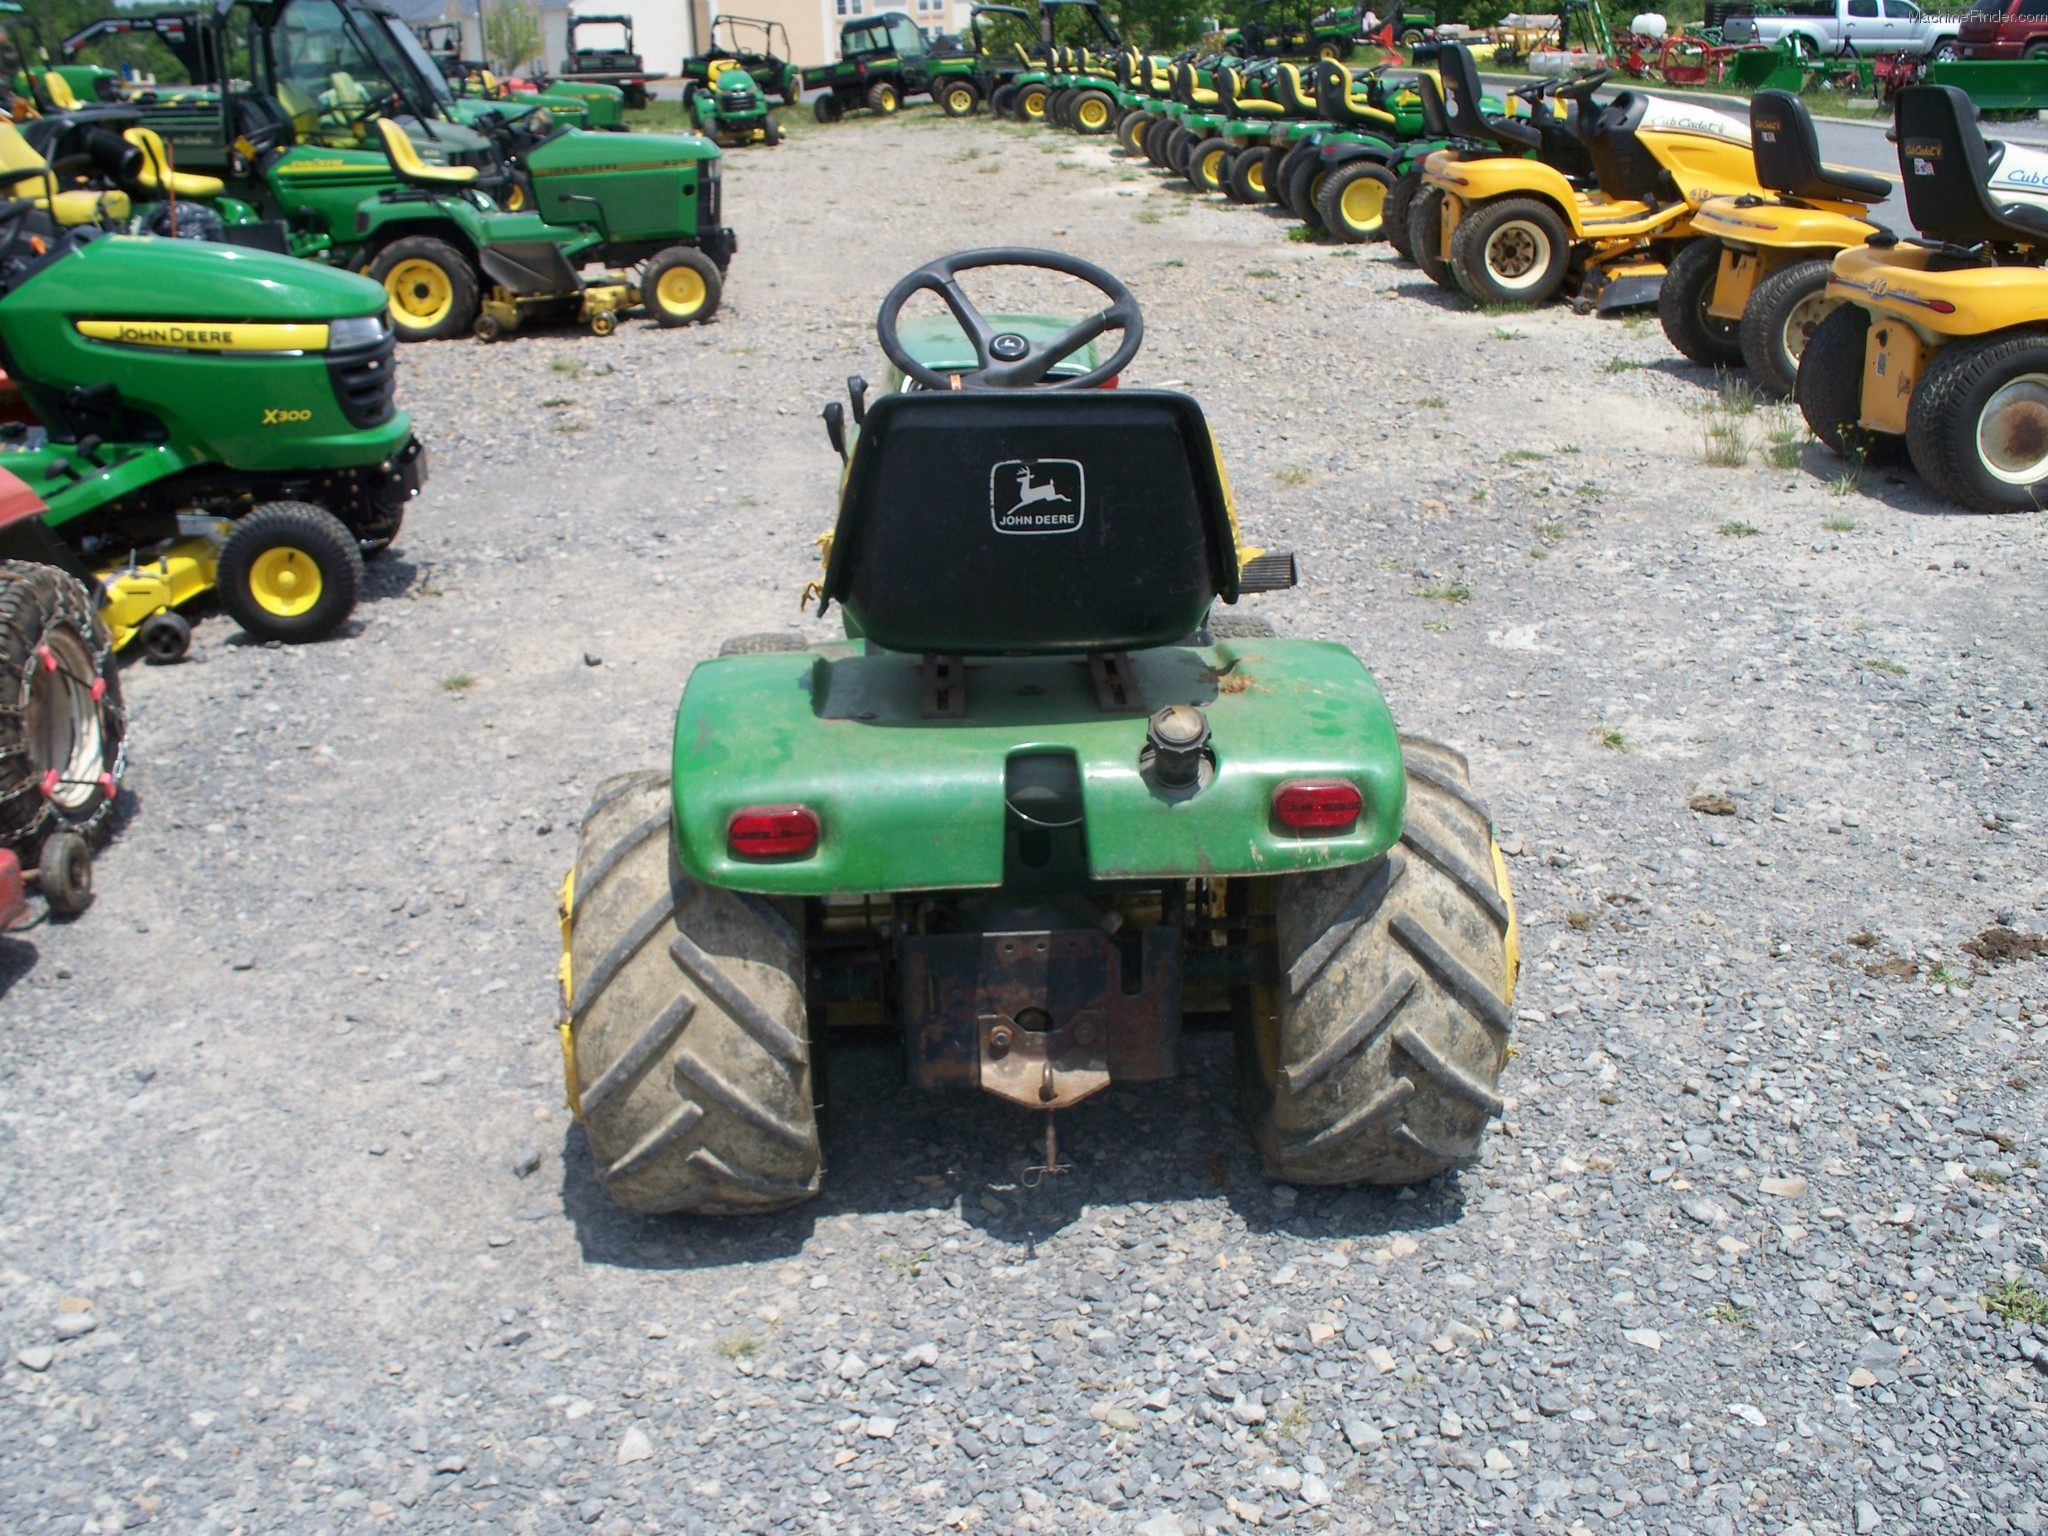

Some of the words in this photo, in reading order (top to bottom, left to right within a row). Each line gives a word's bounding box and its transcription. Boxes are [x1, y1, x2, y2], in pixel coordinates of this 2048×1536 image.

[1652, 115, 1676, 127] Cub
[2007, 169, 2040, 185] Cub
[116, 326, 167, 341] JOHN
[170, 327, 233, 344] DEERE
[262, 408, 312, 424] X300
[1000, 515, 1032, 525] JOHN
[1035, 514, 1075, 524] DEERE
